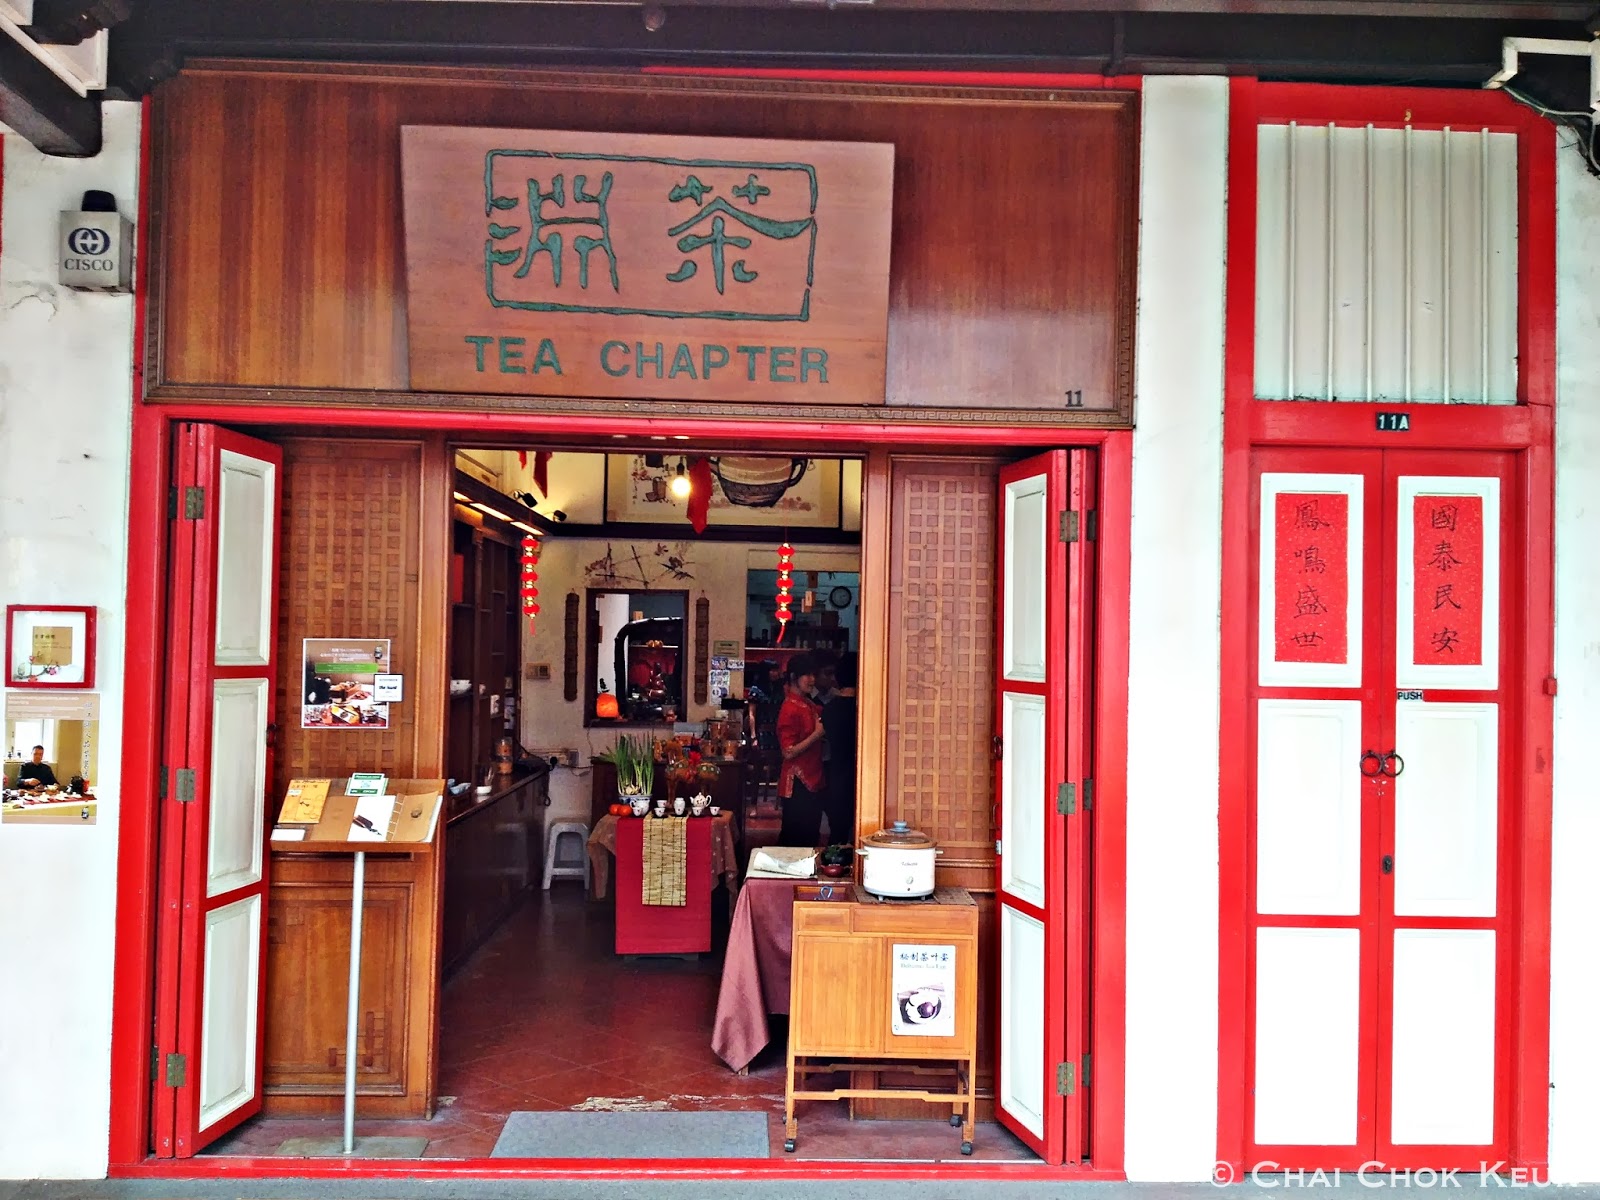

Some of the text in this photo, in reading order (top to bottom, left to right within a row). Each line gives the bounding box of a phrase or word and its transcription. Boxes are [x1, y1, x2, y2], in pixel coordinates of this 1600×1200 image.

[64, 258, 113, 272] CISCO
[465, 336, 829, 384] TEA CHAPTER
[1065, 390, 1083, 407] 11
[1379, 414, 1409, 430] 11A
[1290, 498, 1330, 648] 鳳鳴盛世
[1428, 504, 1463, 654] 國泰民安
[1397, 691, 1423, 700] PUSH
